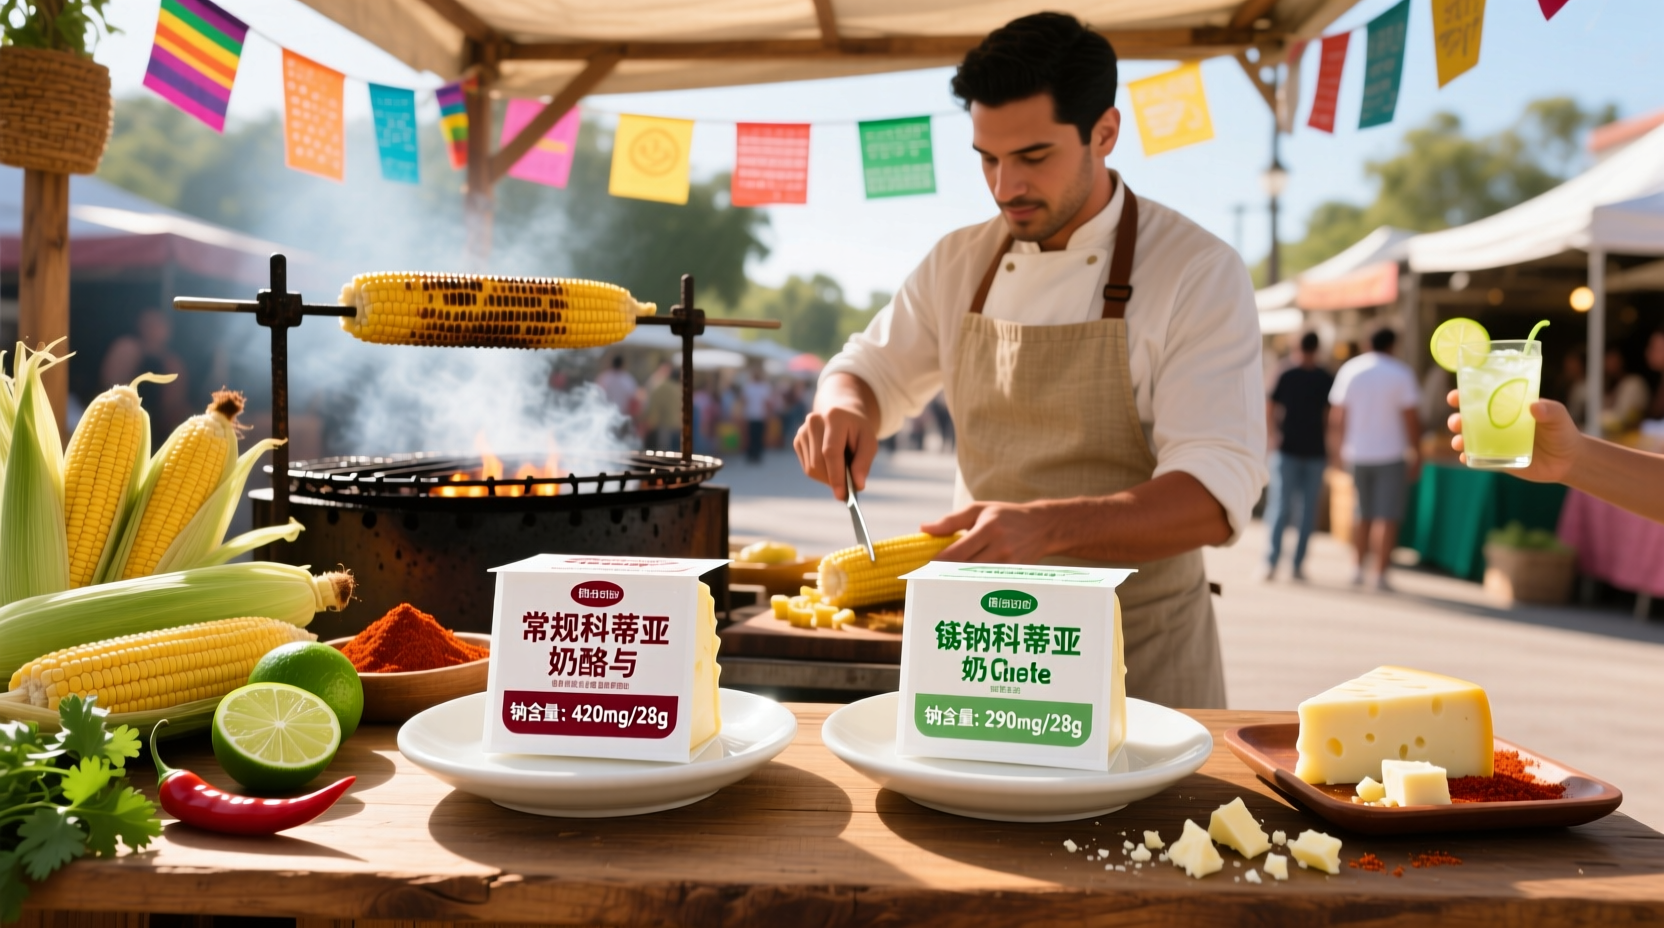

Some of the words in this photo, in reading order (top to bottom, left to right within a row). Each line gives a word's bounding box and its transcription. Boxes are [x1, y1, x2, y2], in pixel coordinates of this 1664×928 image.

[522, 611, 670, 645] 常规科蒂亚
[548, 645, 637, 678] 奶酪与
[572, 705, 669, 730] 420mg/28g
[985, 710, 1082, 738] 290mg/28g
